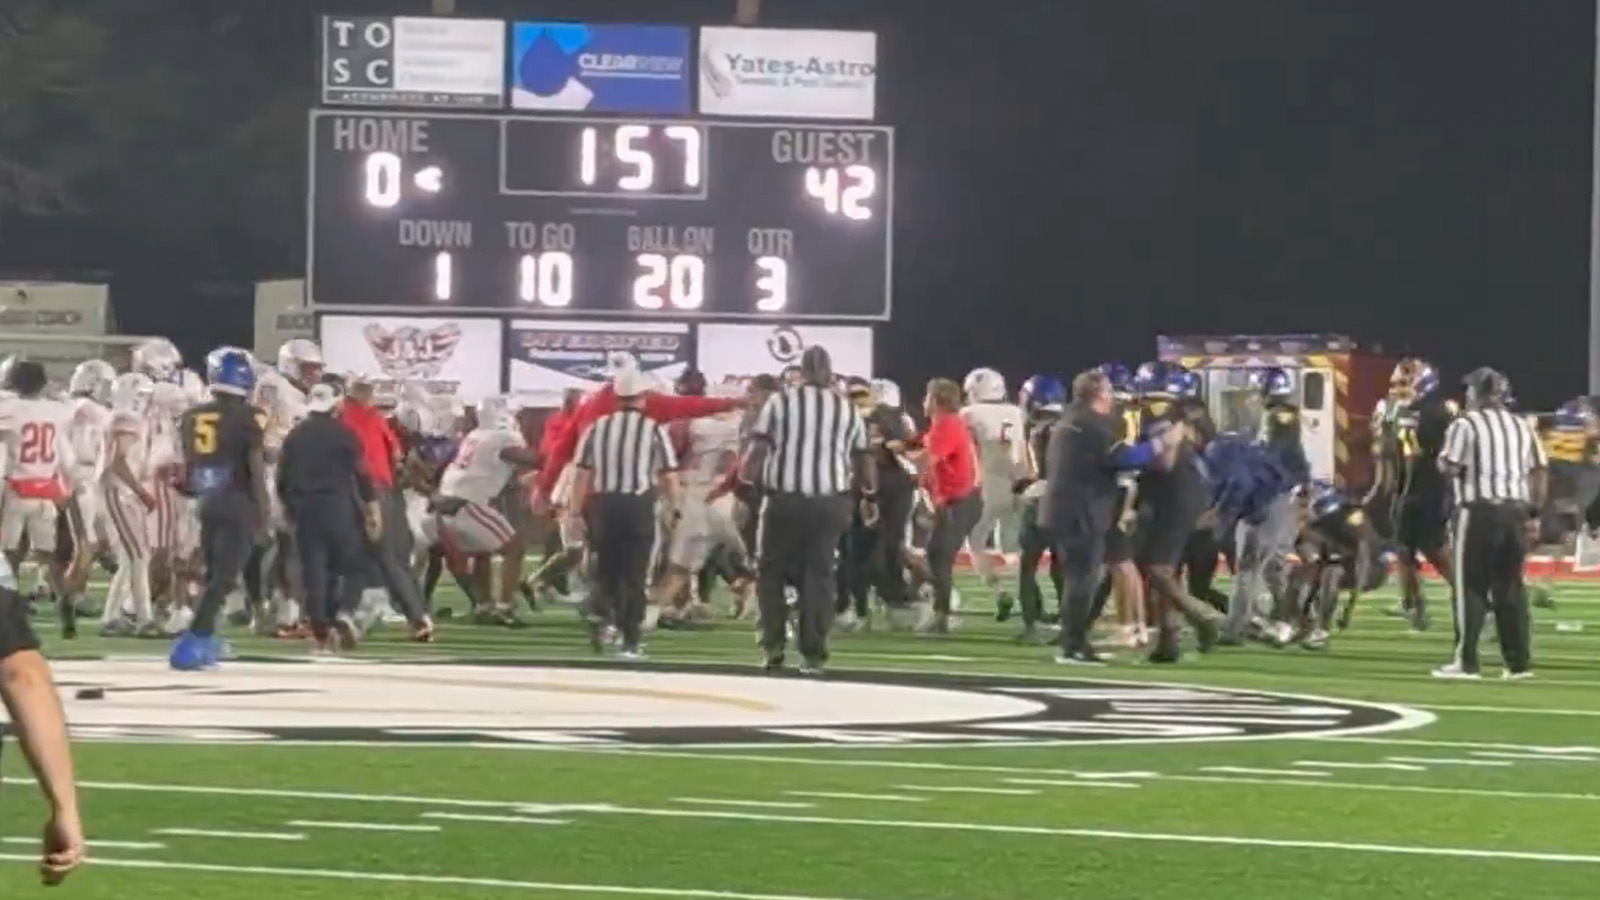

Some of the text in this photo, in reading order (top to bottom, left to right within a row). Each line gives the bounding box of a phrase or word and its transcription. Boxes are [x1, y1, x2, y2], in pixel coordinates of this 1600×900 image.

[726, 53, 876, 77] Yates-Astro
[334, 118, 430, 152] HOME
[772, 130, 875, 164] GUEST
[366, 151, 401, 208] 0
[805, 165, 876, 220] 42
[400, 219, 472, 247] DOWN
[505, 221, 576, 250] TO GO
[683, 226, 715, 254] ON
[436, 251, 451, 300] 1
[520, 252, 573, 307] 10
[634, 253, 704, 310] 20
[756, 256, 787, 311] 3
[20, 422, 56, 464] 20
[192, 412, 221, 454] 5
